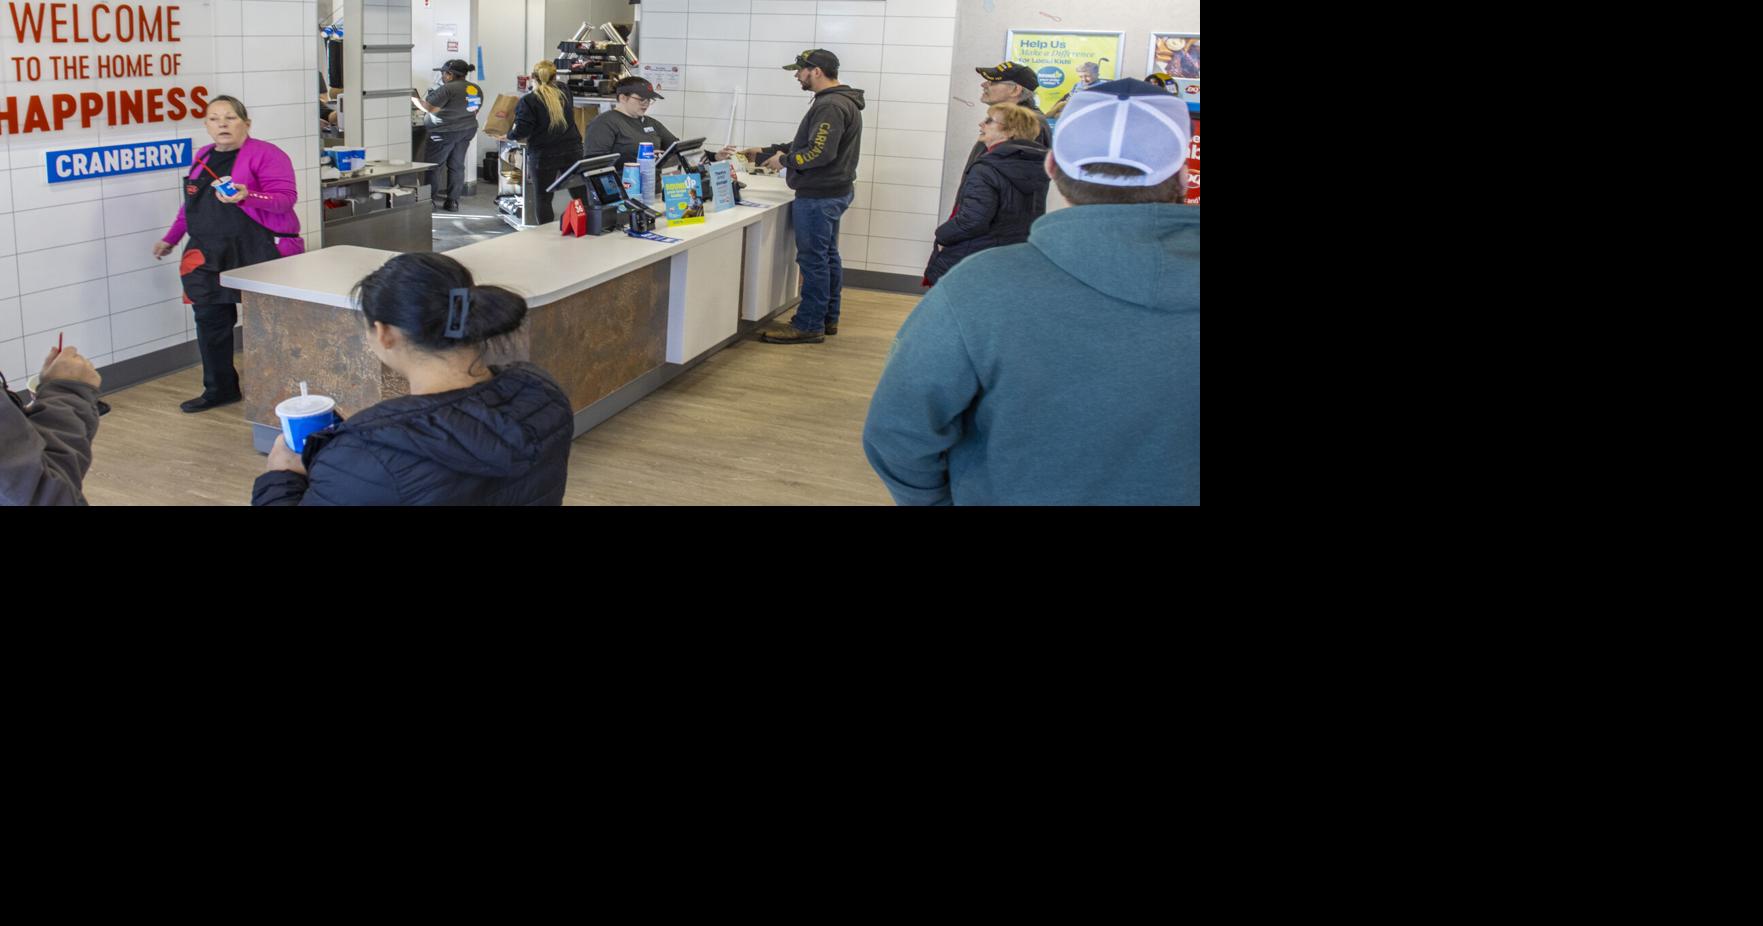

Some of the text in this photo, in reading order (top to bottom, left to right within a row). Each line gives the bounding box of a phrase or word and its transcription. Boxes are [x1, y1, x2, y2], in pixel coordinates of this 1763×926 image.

[9, 2, 181, 44] WELCOME
[1020, 40, 1067, 49] Help Us
[1021, 49, 1041, 57] Make
[11, 53, 182, 82] TO THE HOME OF
[0, 85, 209, 135] HAPPINESS
[55, 142, 185, 178] CRANBERRY
